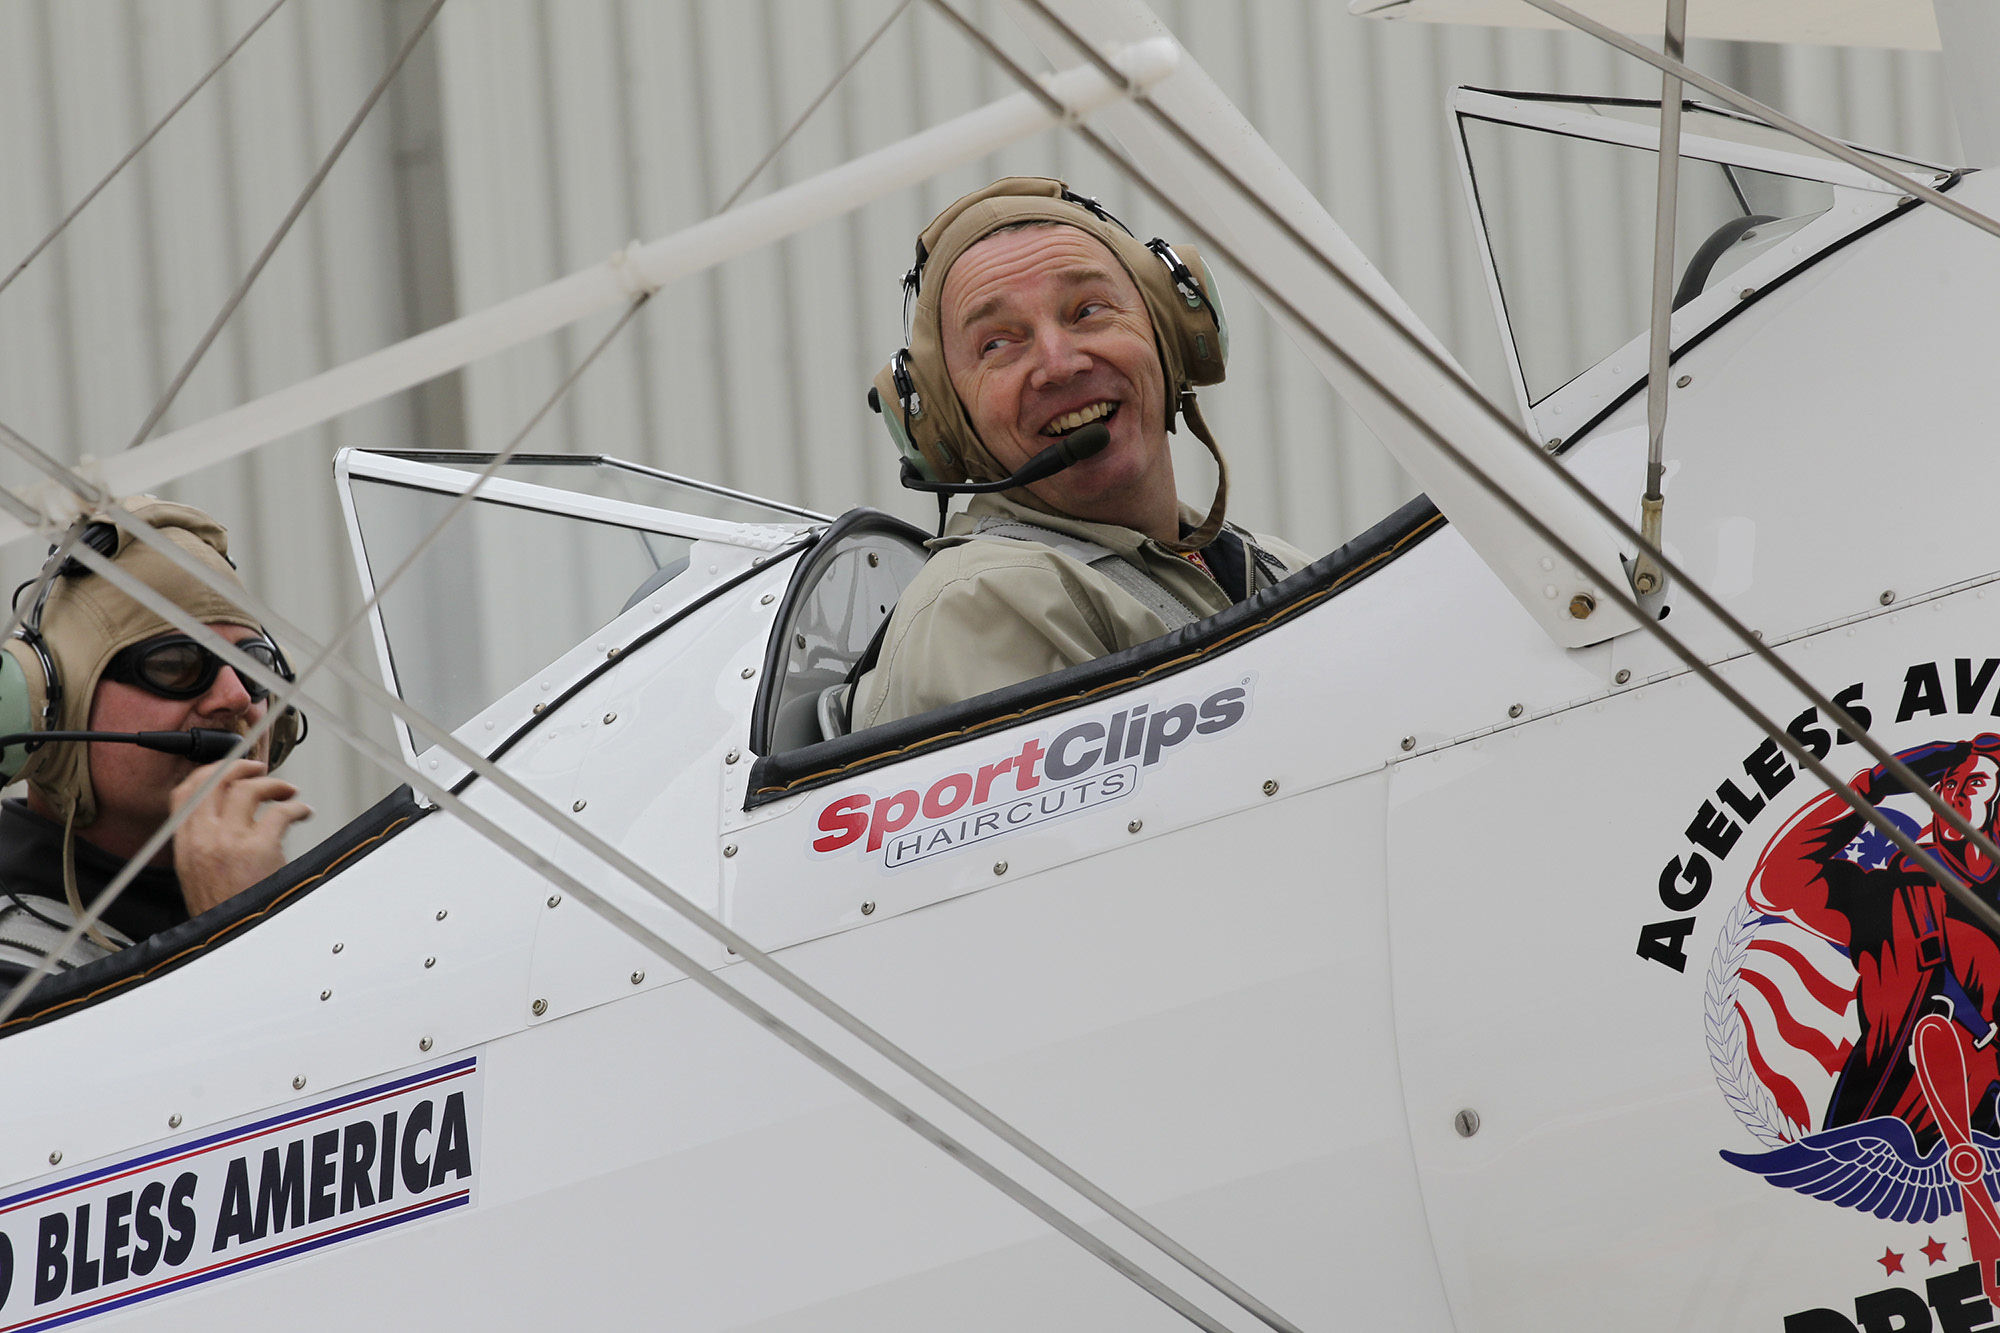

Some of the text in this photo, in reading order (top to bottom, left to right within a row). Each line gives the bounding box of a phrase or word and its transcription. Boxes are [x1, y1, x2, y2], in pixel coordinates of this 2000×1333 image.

[896, 773, 1126, 861] HAIRCUTS
[1635, 658, 2000, 974] AGELESS AV
[34, 1171, 199, 1306] BLESS
[211, 1090, 473, 1254] AMERICA
